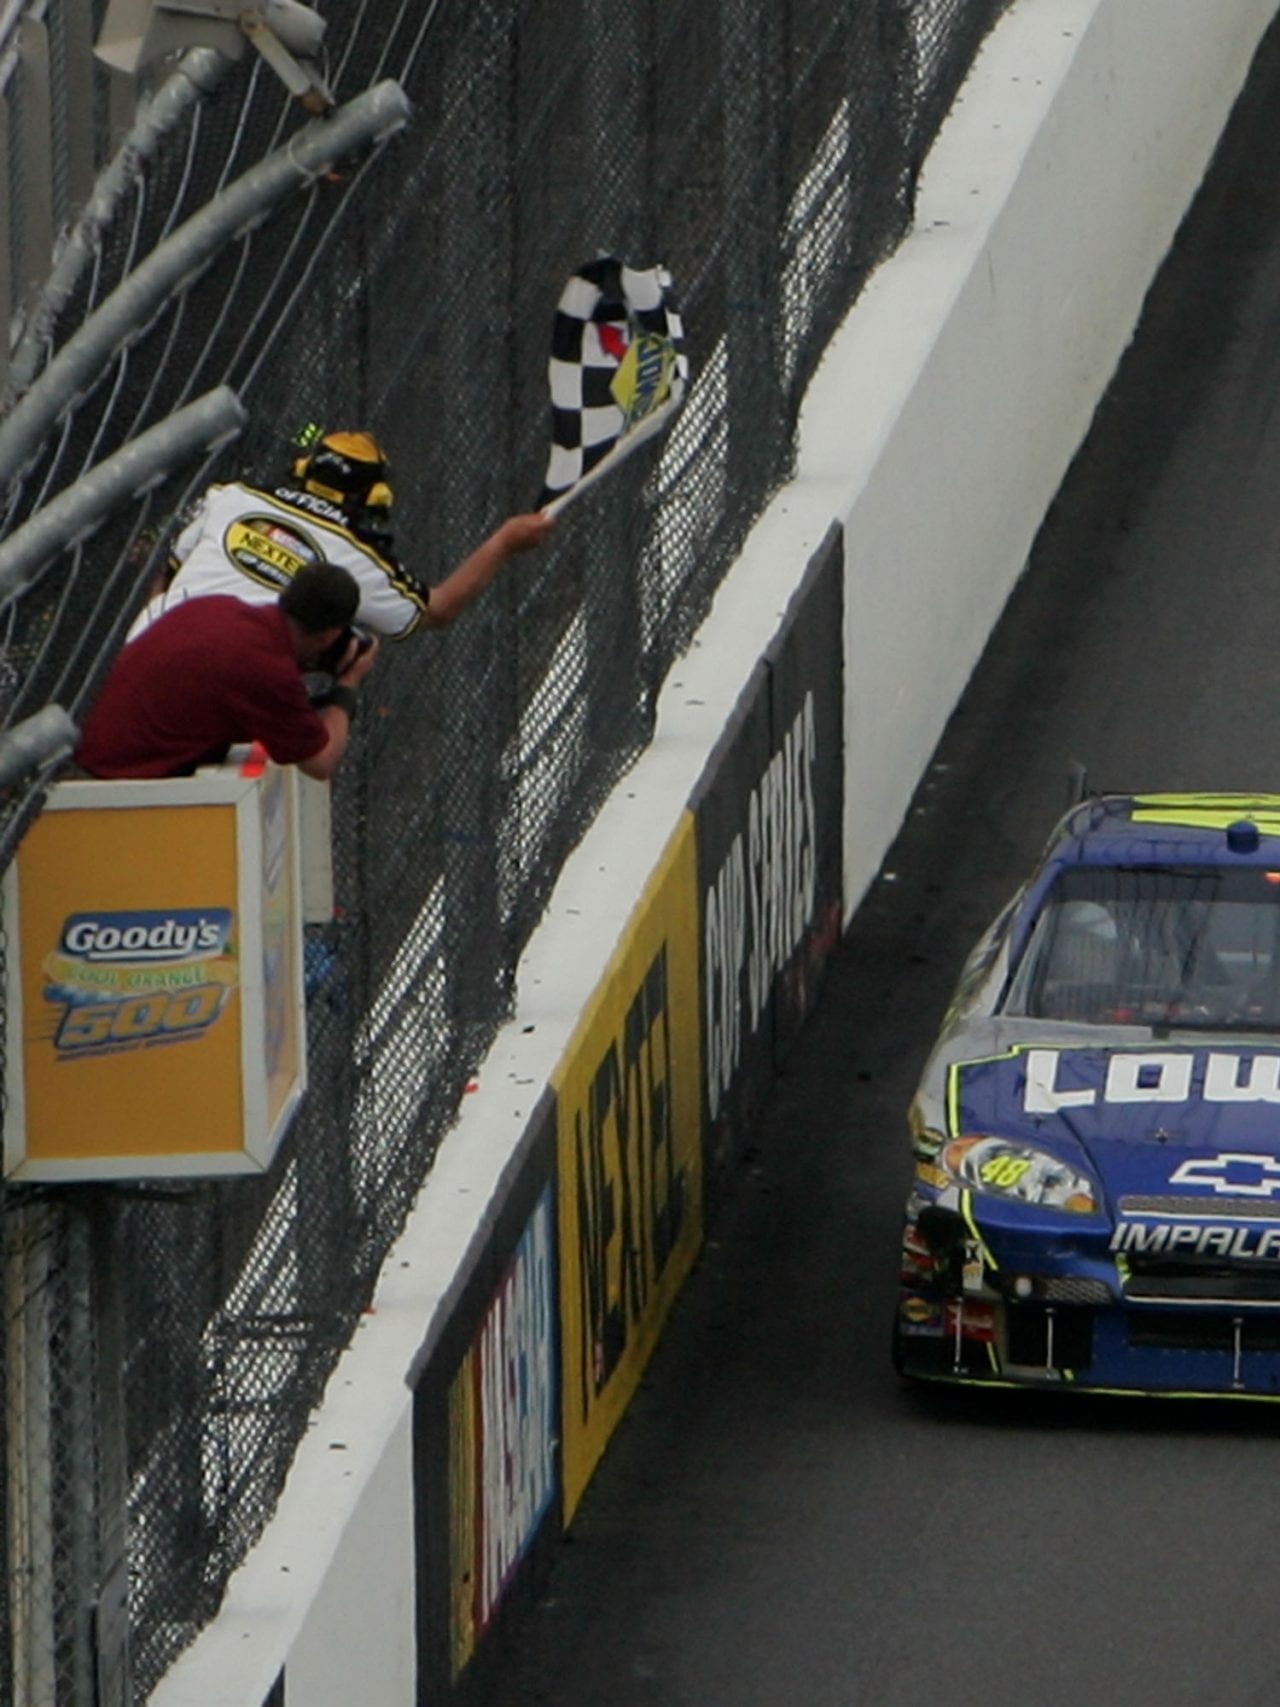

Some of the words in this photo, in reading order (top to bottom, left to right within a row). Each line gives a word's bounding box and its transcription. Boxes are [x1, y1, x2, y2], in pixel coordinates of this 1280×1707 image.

[274, 486, 350, 526] OFFICIAL
[239, 531, 302, 575] NEXTE
[705, 832, 746, 1122] CUP
[748, 690, 817, 1034] SERIES
[64, 918, 221, 954] Goody's
[55, 980, 230, 1050] 500
[574, 938, 688, 1427] NEXTEL
[980, 1154, 1032, 1188] 48
